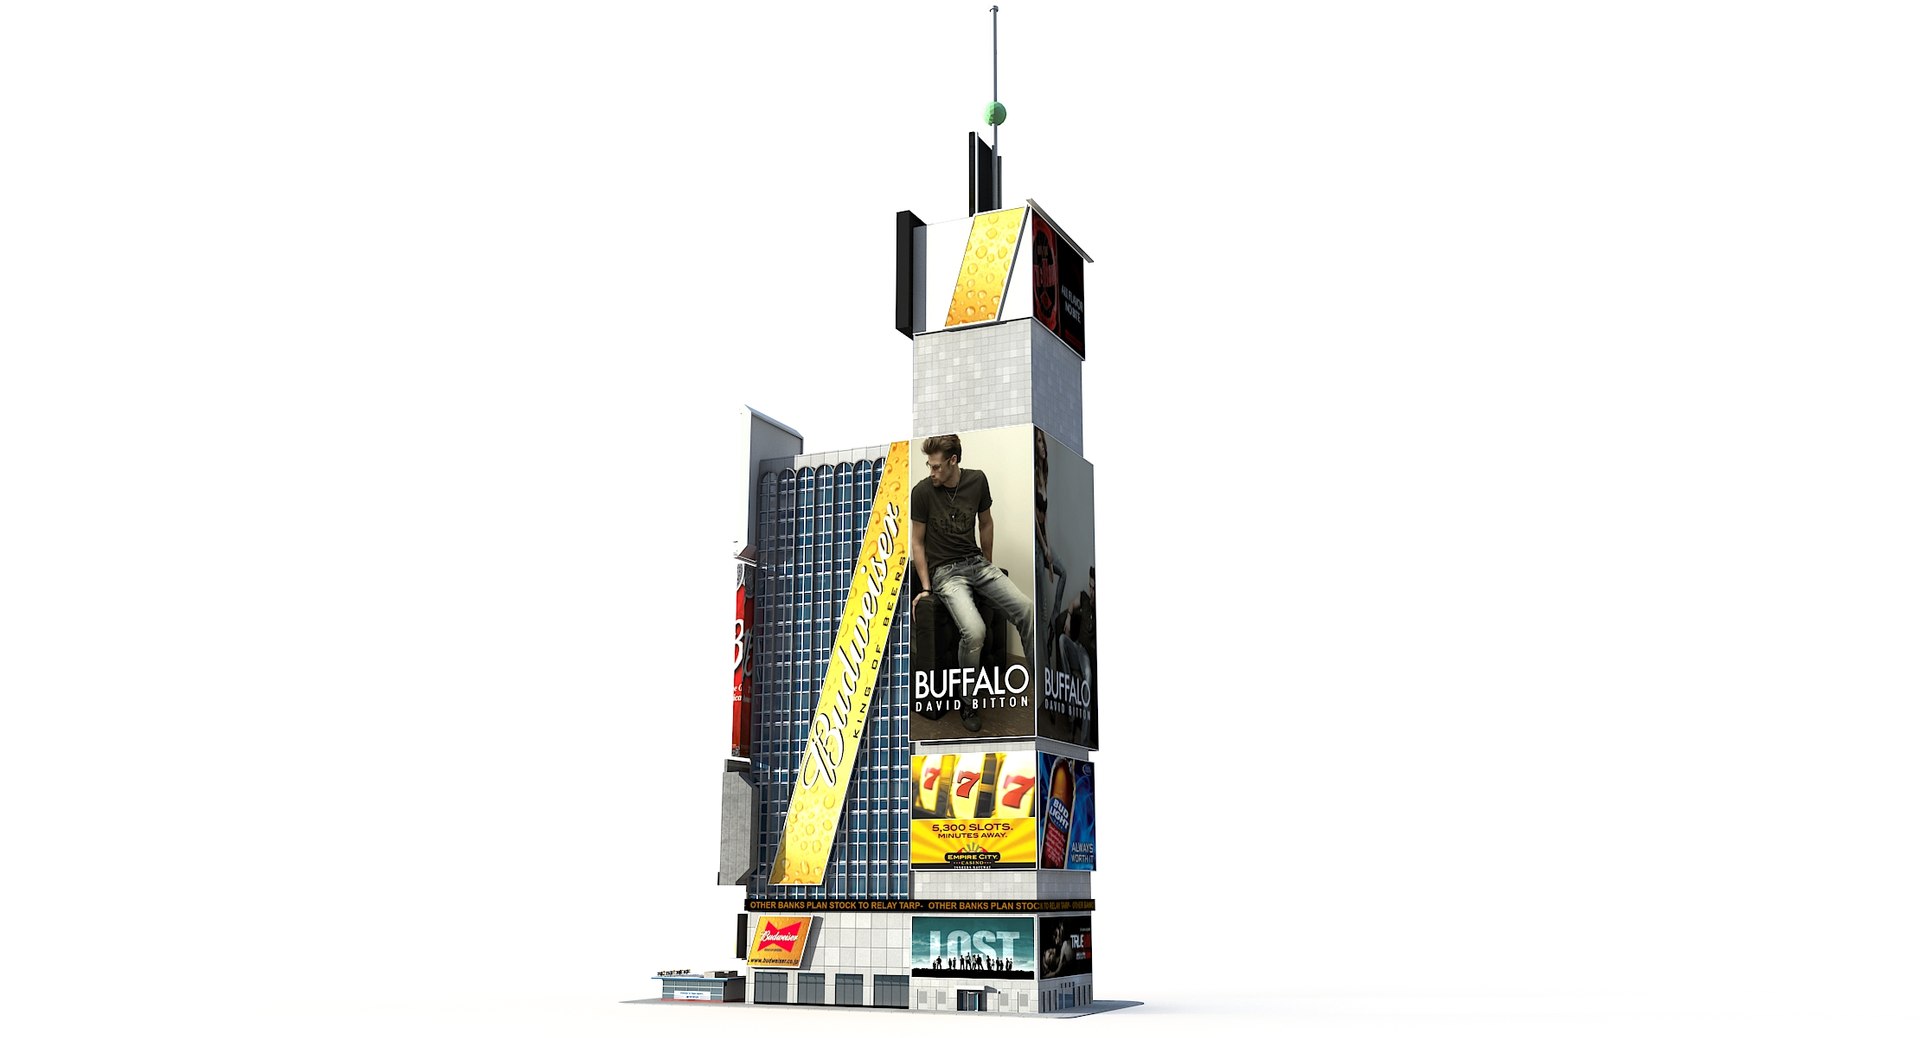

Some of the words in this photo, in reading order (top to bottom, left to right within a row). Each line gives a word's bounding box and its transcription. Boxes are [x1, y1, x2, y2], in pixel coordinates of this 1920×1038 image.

[803, 501, 900, 788] Budweiser
[853, 687, 871, 739] KING
[871, 645, 881, 670] OF
[883, 556, 906, 627] BEERS
[915, 664, 1029, 699] BUFFALO
[1044, 667, 1091, 708] BUFFALO
[915, 699, 961, 712] DAVID
[972, 696, 1028, 709] BITTON
[1044, 698, 1065, 714] DAVID
[1068, 705, 1091, 721] BITTON
[924, 768, 941, 790] 7
[956, 770, 980, 798] 7
[1002, 774, 1035, 809] 7
[1050, 806, 1069, 829] LIGHT
[1053, 799, 1069, 818] BUD
[932, 823, 966, 832] 5,300
[968, 823, 1014, 831] SLOTS.
[1072, 842, 1093, 853] ALWAYS
[1072, 854, 1088, 863] WORTH
[1089, 854, 1094, 863] IT
[750, 901, 776, 909] OTHER
[778, 901, 805, 909] BANKS
[806, 901, 828, 909] PLAN
[829, 901, 857, 909] STOCK
[858, 901, 869, 909] TO
[871, 901, 896, 909] RELAY
[928, 901, 957, 910] OTHER
[959, 901, 989, 910] BANKS
[990, 901, 1018, 910] PLAN
[760, 930, 799, 942] Budweiser
[1070, 934, 1084, 949] TRUE
[930, 930, 1020, 966] LOST
